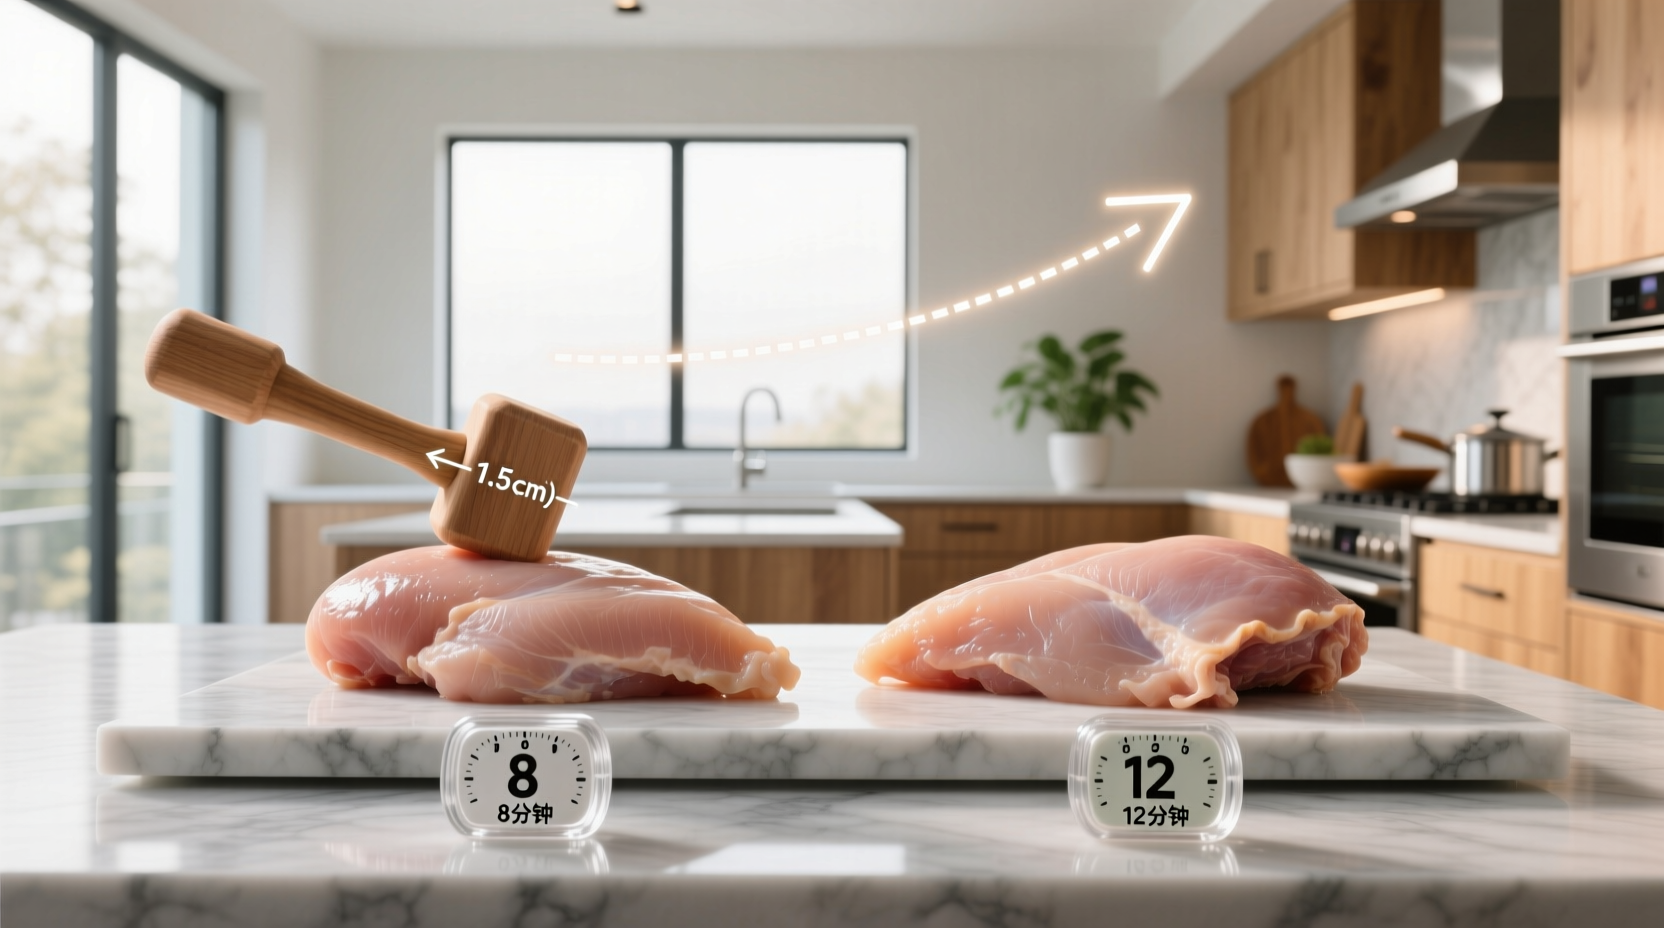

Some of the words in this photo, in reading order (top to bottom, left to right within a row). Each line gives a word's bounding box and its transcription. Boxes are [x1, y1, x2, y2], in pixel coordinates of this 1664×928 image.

[508, 753, 538, 799] 8
[1124, 755, 1175, 800] 12
[497, 803, 553, 825] 8分钟
[1122, 804, 1189, 827] 12分钟
